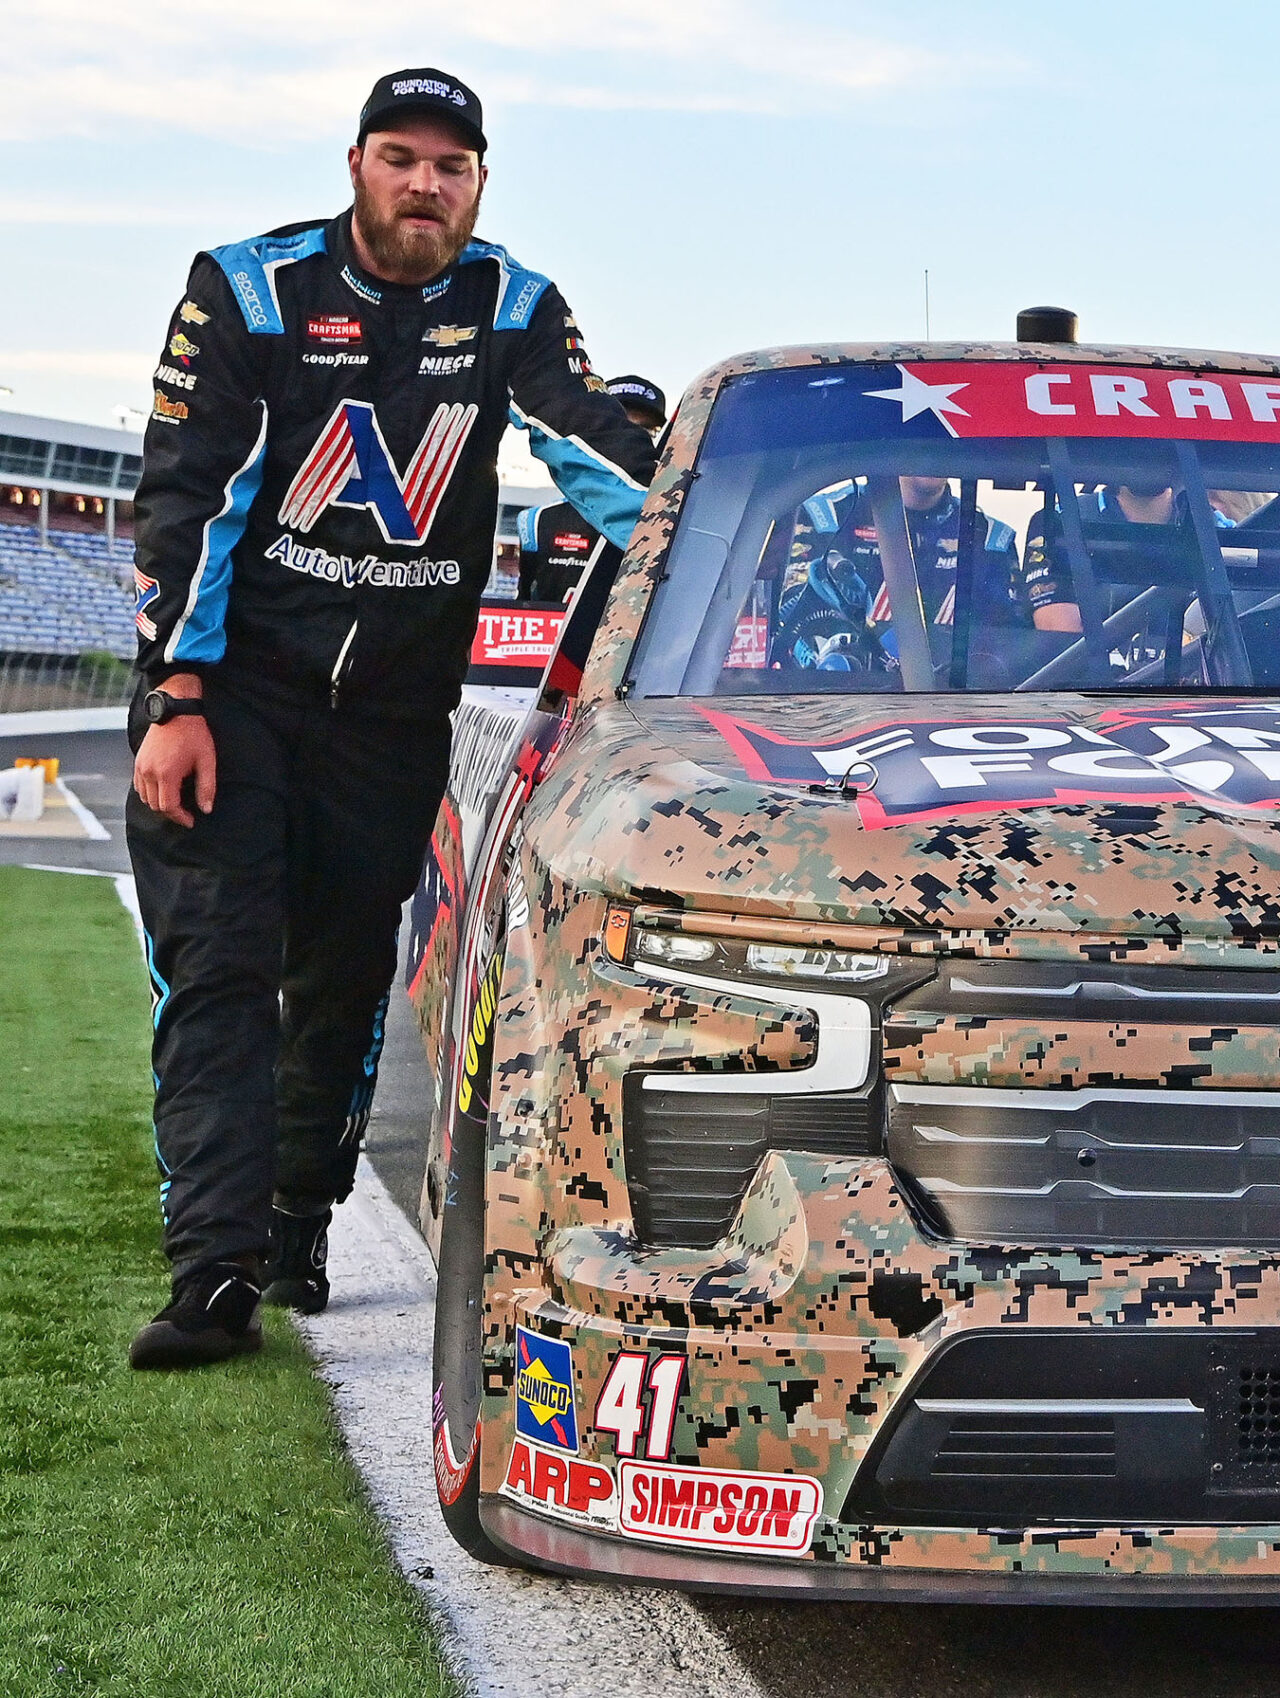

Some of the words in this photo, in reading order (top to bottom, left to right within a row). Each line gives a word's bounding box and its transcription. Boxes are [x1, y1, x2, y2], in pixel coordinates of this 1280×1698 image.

[391, 79, 451, 93] FOUNDATION
[393, 87, 416, 96] FOR
[417, 87, 447, 98] POPS
[233, 270, 268, 328] sparco
[509, 279, 542, 324] sparco
[308, 322, 362, 336] CRAFTSMAN
[153, 363, 198, 391] NIECE
[302, 352, 370, 368] GOODYEAR
[420, 353, 477, 371] NIECE
[264, 533, 461, 588] AutoVentive
[478, 614, 544, 646] THE
[518, 1372, 568, 1412] SUNOCO
[595, 1352, 689, 1460] 41
[506, 1440, 615, 1513] ARP
[629, 1472, 803, 1539] SIMPSON
